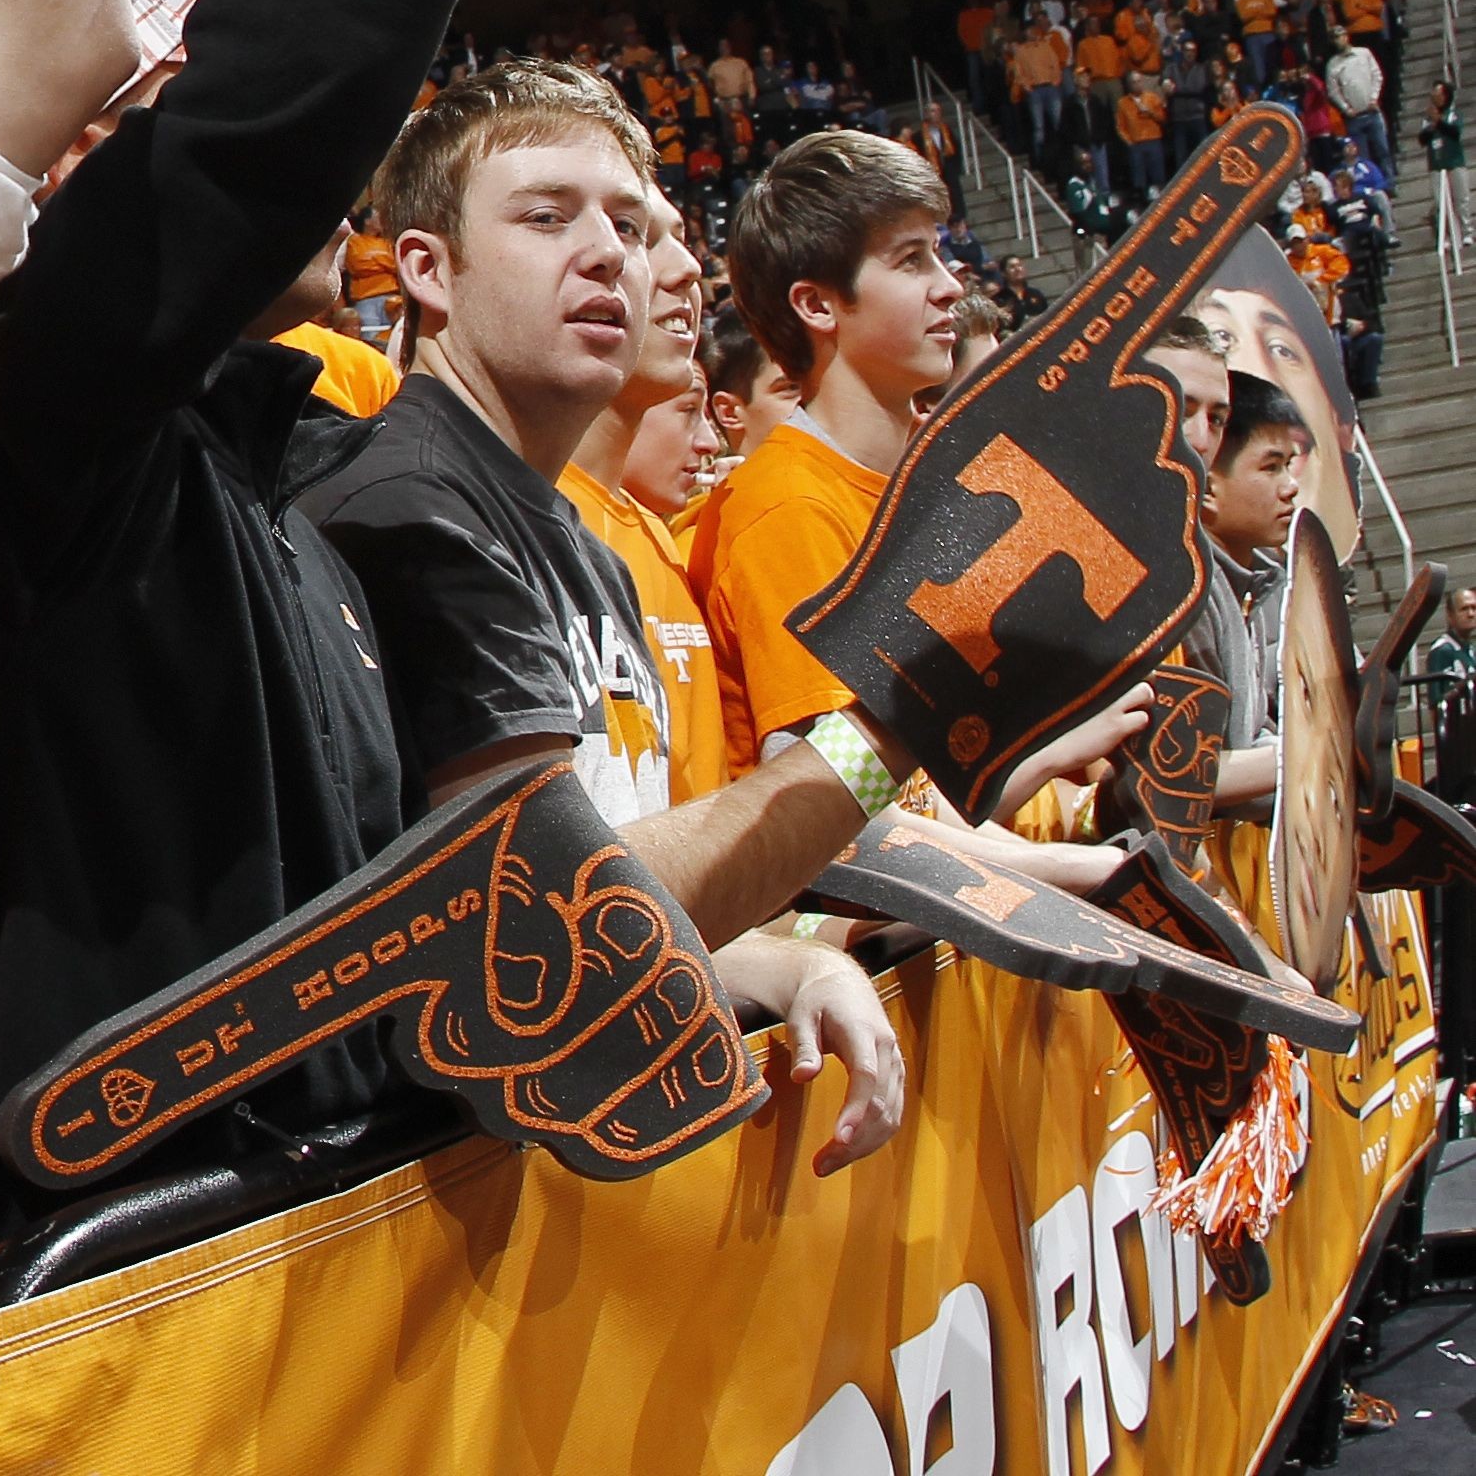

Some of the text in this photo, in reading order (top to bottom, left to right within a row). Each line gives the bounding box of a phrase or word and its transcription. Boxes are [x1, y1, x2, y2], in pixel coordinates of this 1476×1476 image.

[1168, 191, 1221, 247] UT
[1037, 266, 1158, 394] HOOPS
[905, 433, 1148, 673] T
[664, 648, 691, 683] T
[175, 1000, 256, 1077] UT
[292, 885, 484, 1012] HOOPS
